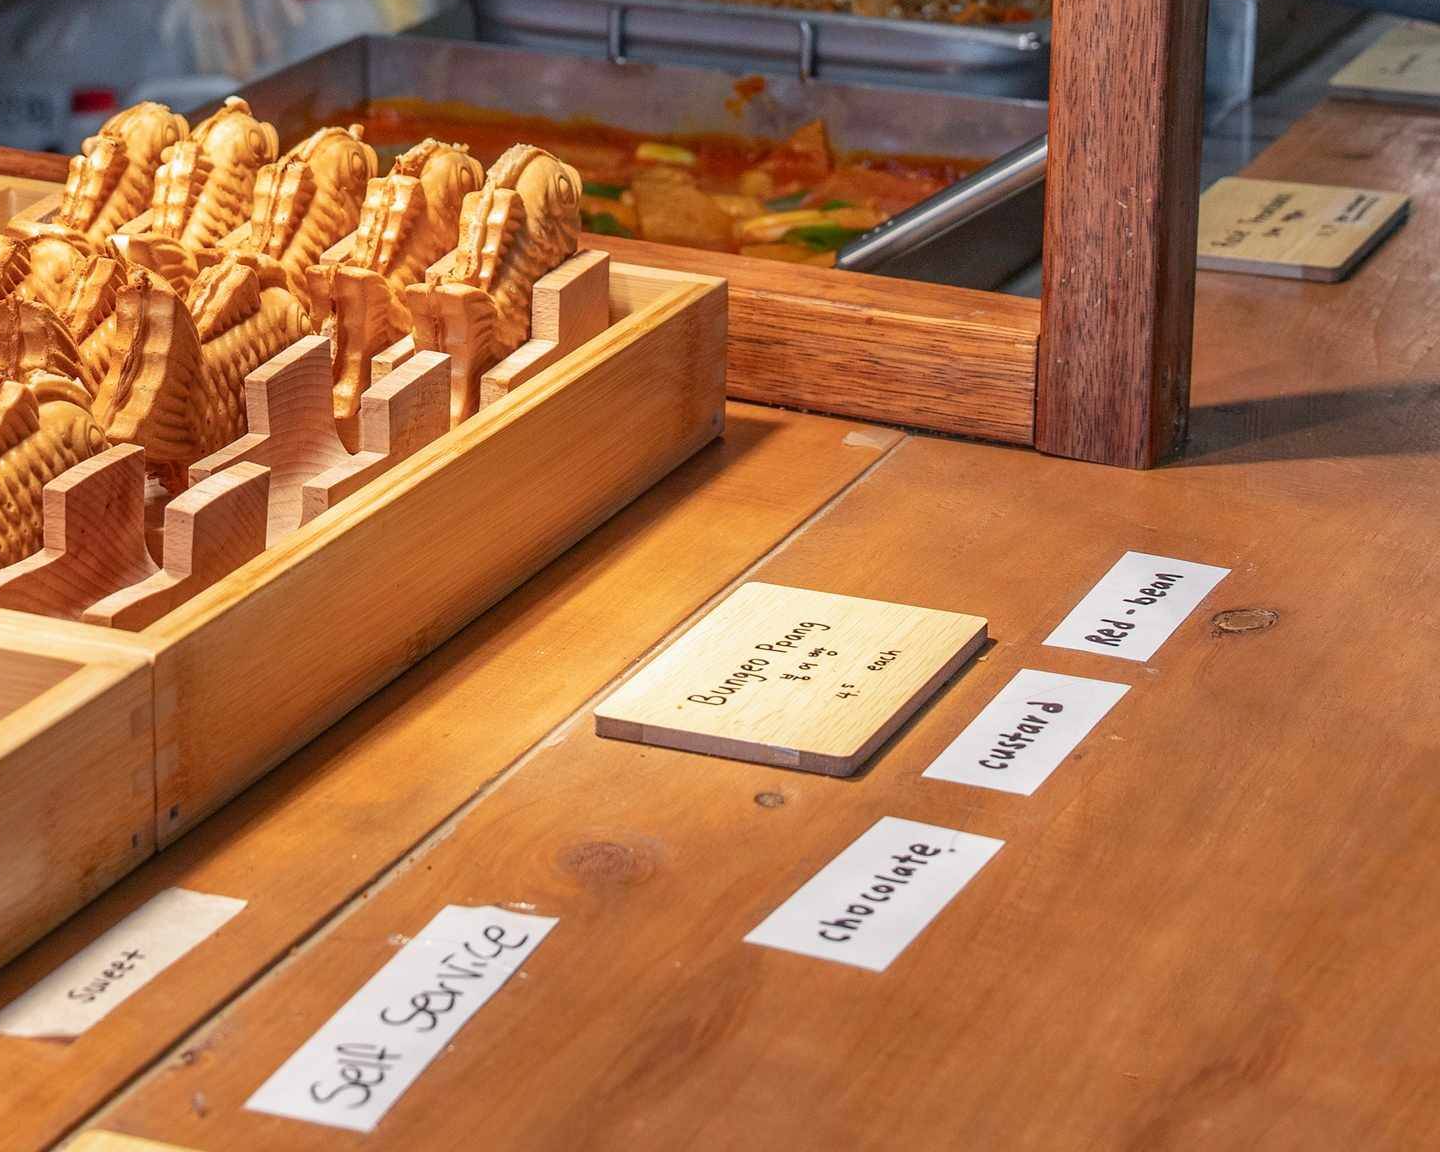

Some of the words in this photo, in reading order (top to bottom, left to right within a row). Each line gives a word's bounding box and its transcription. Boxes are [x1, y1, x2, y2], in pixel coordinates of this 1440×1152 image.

[686, 658, 770, 706] Bungeo
[754, 621, 832, 654] Ppang
[866, 649, 902, 672] each
[978, 700, 1065, 771] custard
